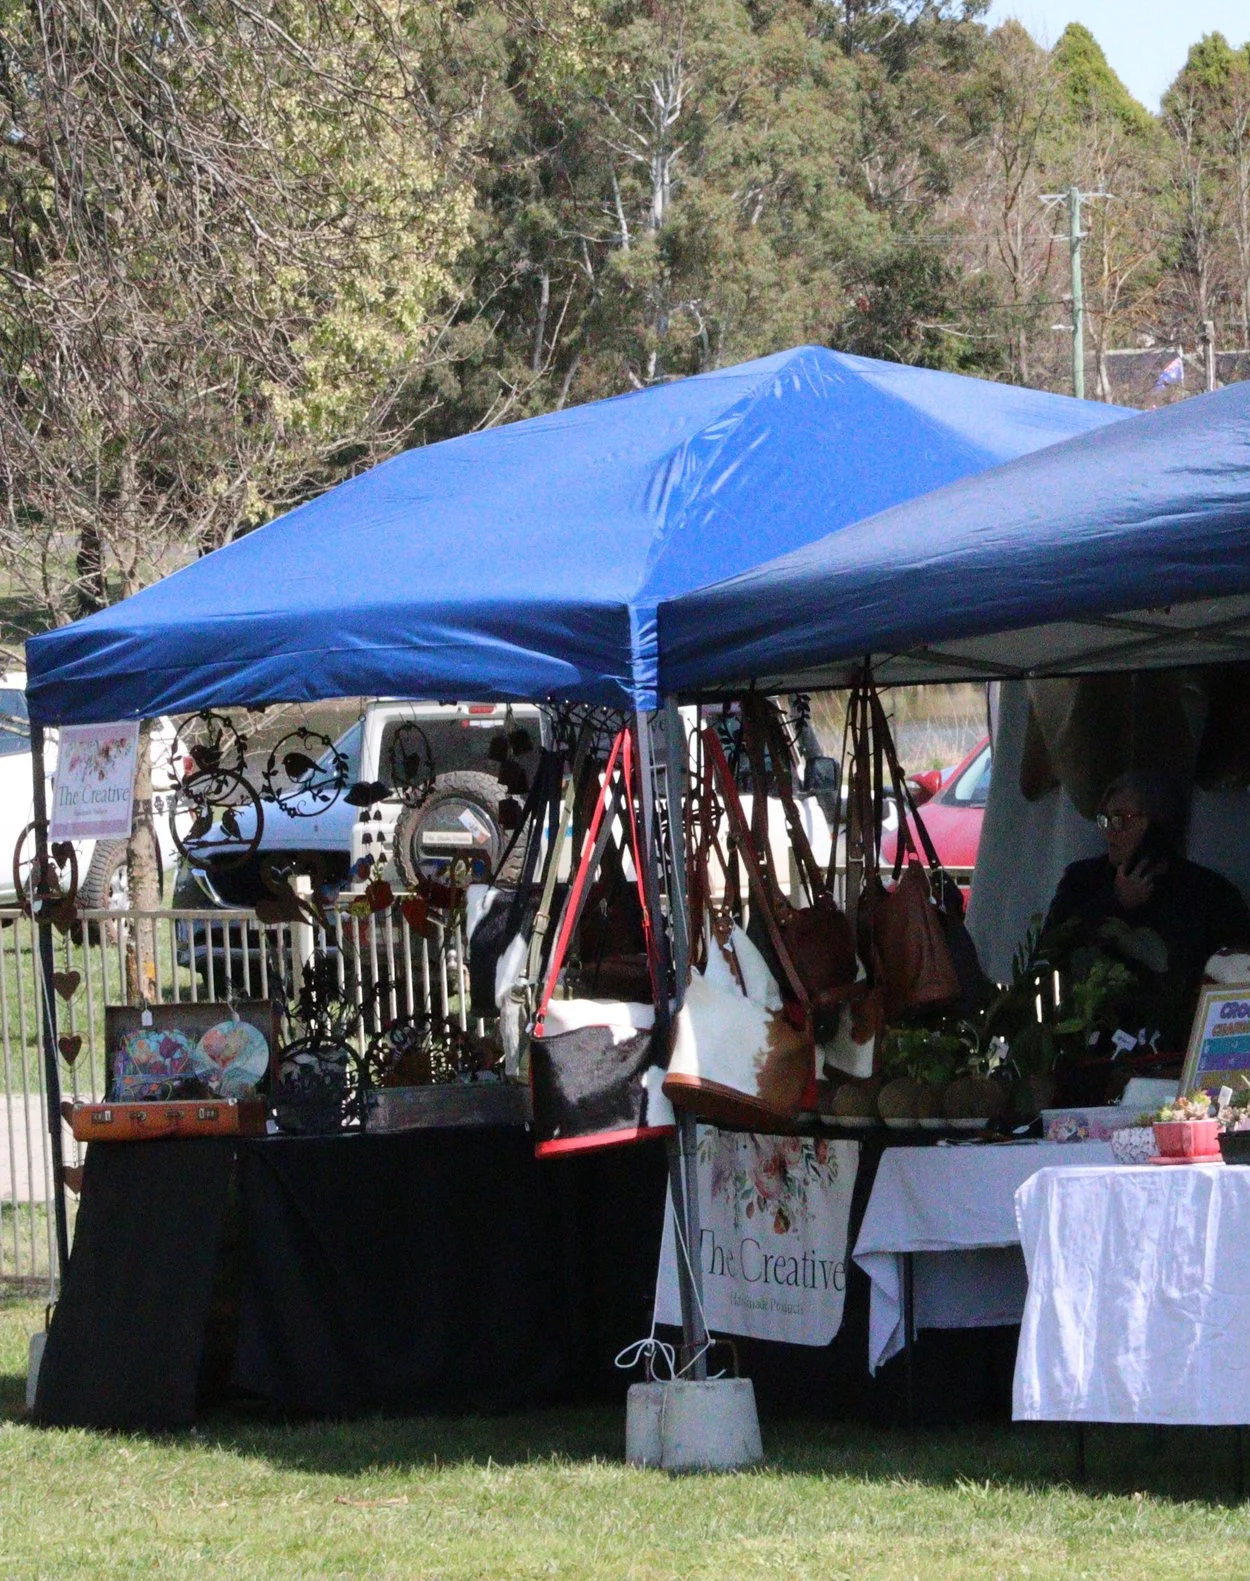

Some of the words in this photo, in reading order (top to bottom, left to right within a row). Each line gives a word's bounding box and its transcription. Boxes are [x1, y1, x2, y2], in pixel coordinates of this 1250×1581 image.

[59, 785, 80, 806] The
[82, 783, 130, 804] Creative
[700, 1229, 734, 1278] The
[740, 1238, 847, 1291] Creative
